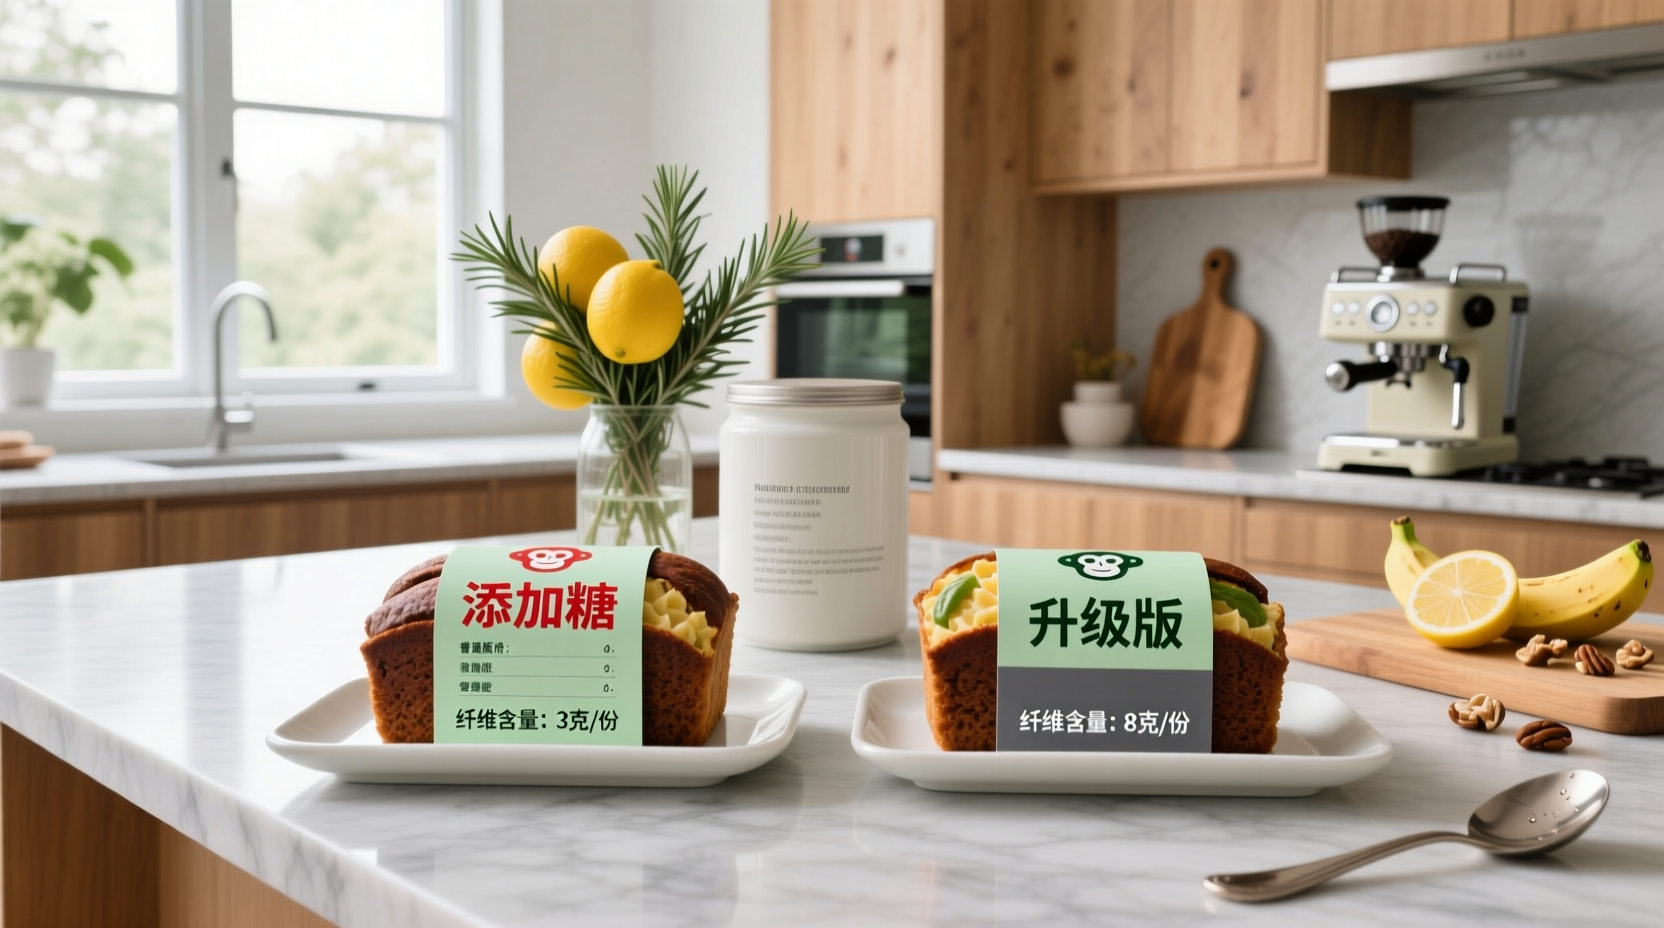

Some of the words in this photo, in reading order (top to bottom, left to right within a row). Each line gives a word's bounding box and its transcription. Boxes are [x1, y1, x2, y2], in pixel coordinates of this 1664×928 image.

[461, 581, 619, 630] 添加糖
[1028, 597, 1184, 649] 升级版
